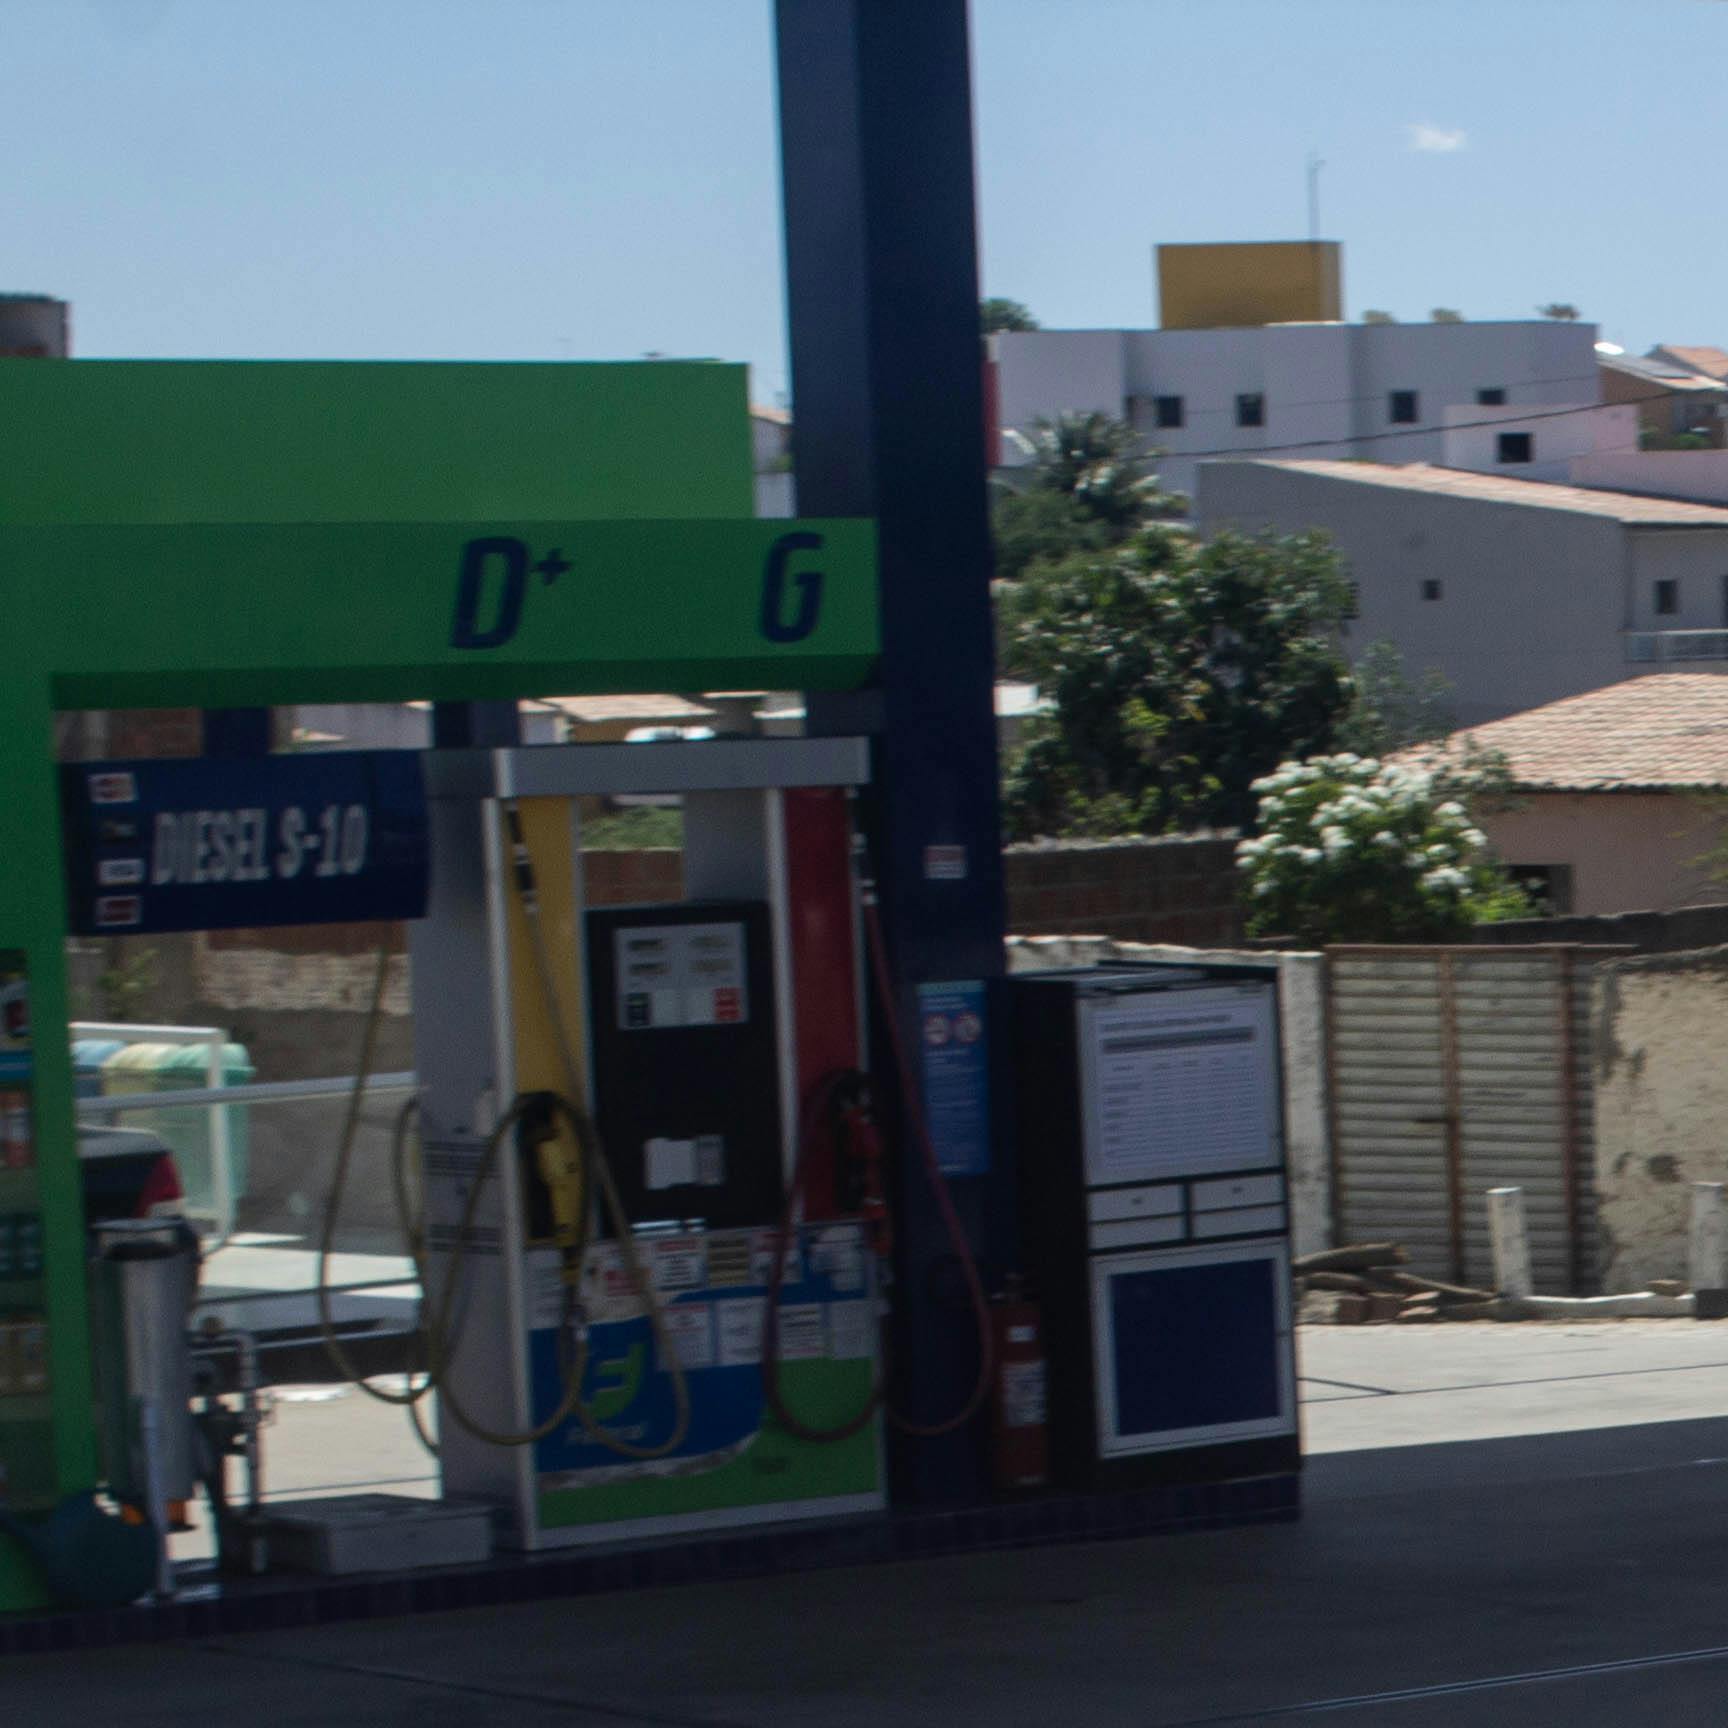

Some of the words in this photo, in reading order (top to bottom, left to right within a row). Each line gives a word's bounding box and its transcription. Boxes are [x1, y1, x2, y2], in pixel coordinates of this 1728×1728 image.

[449, 536, 573, 650] D+
[760, 531, 825, 643] G
[151, 808, 270, 886] DIESEL
[277, 804, 368, 880] S-10
